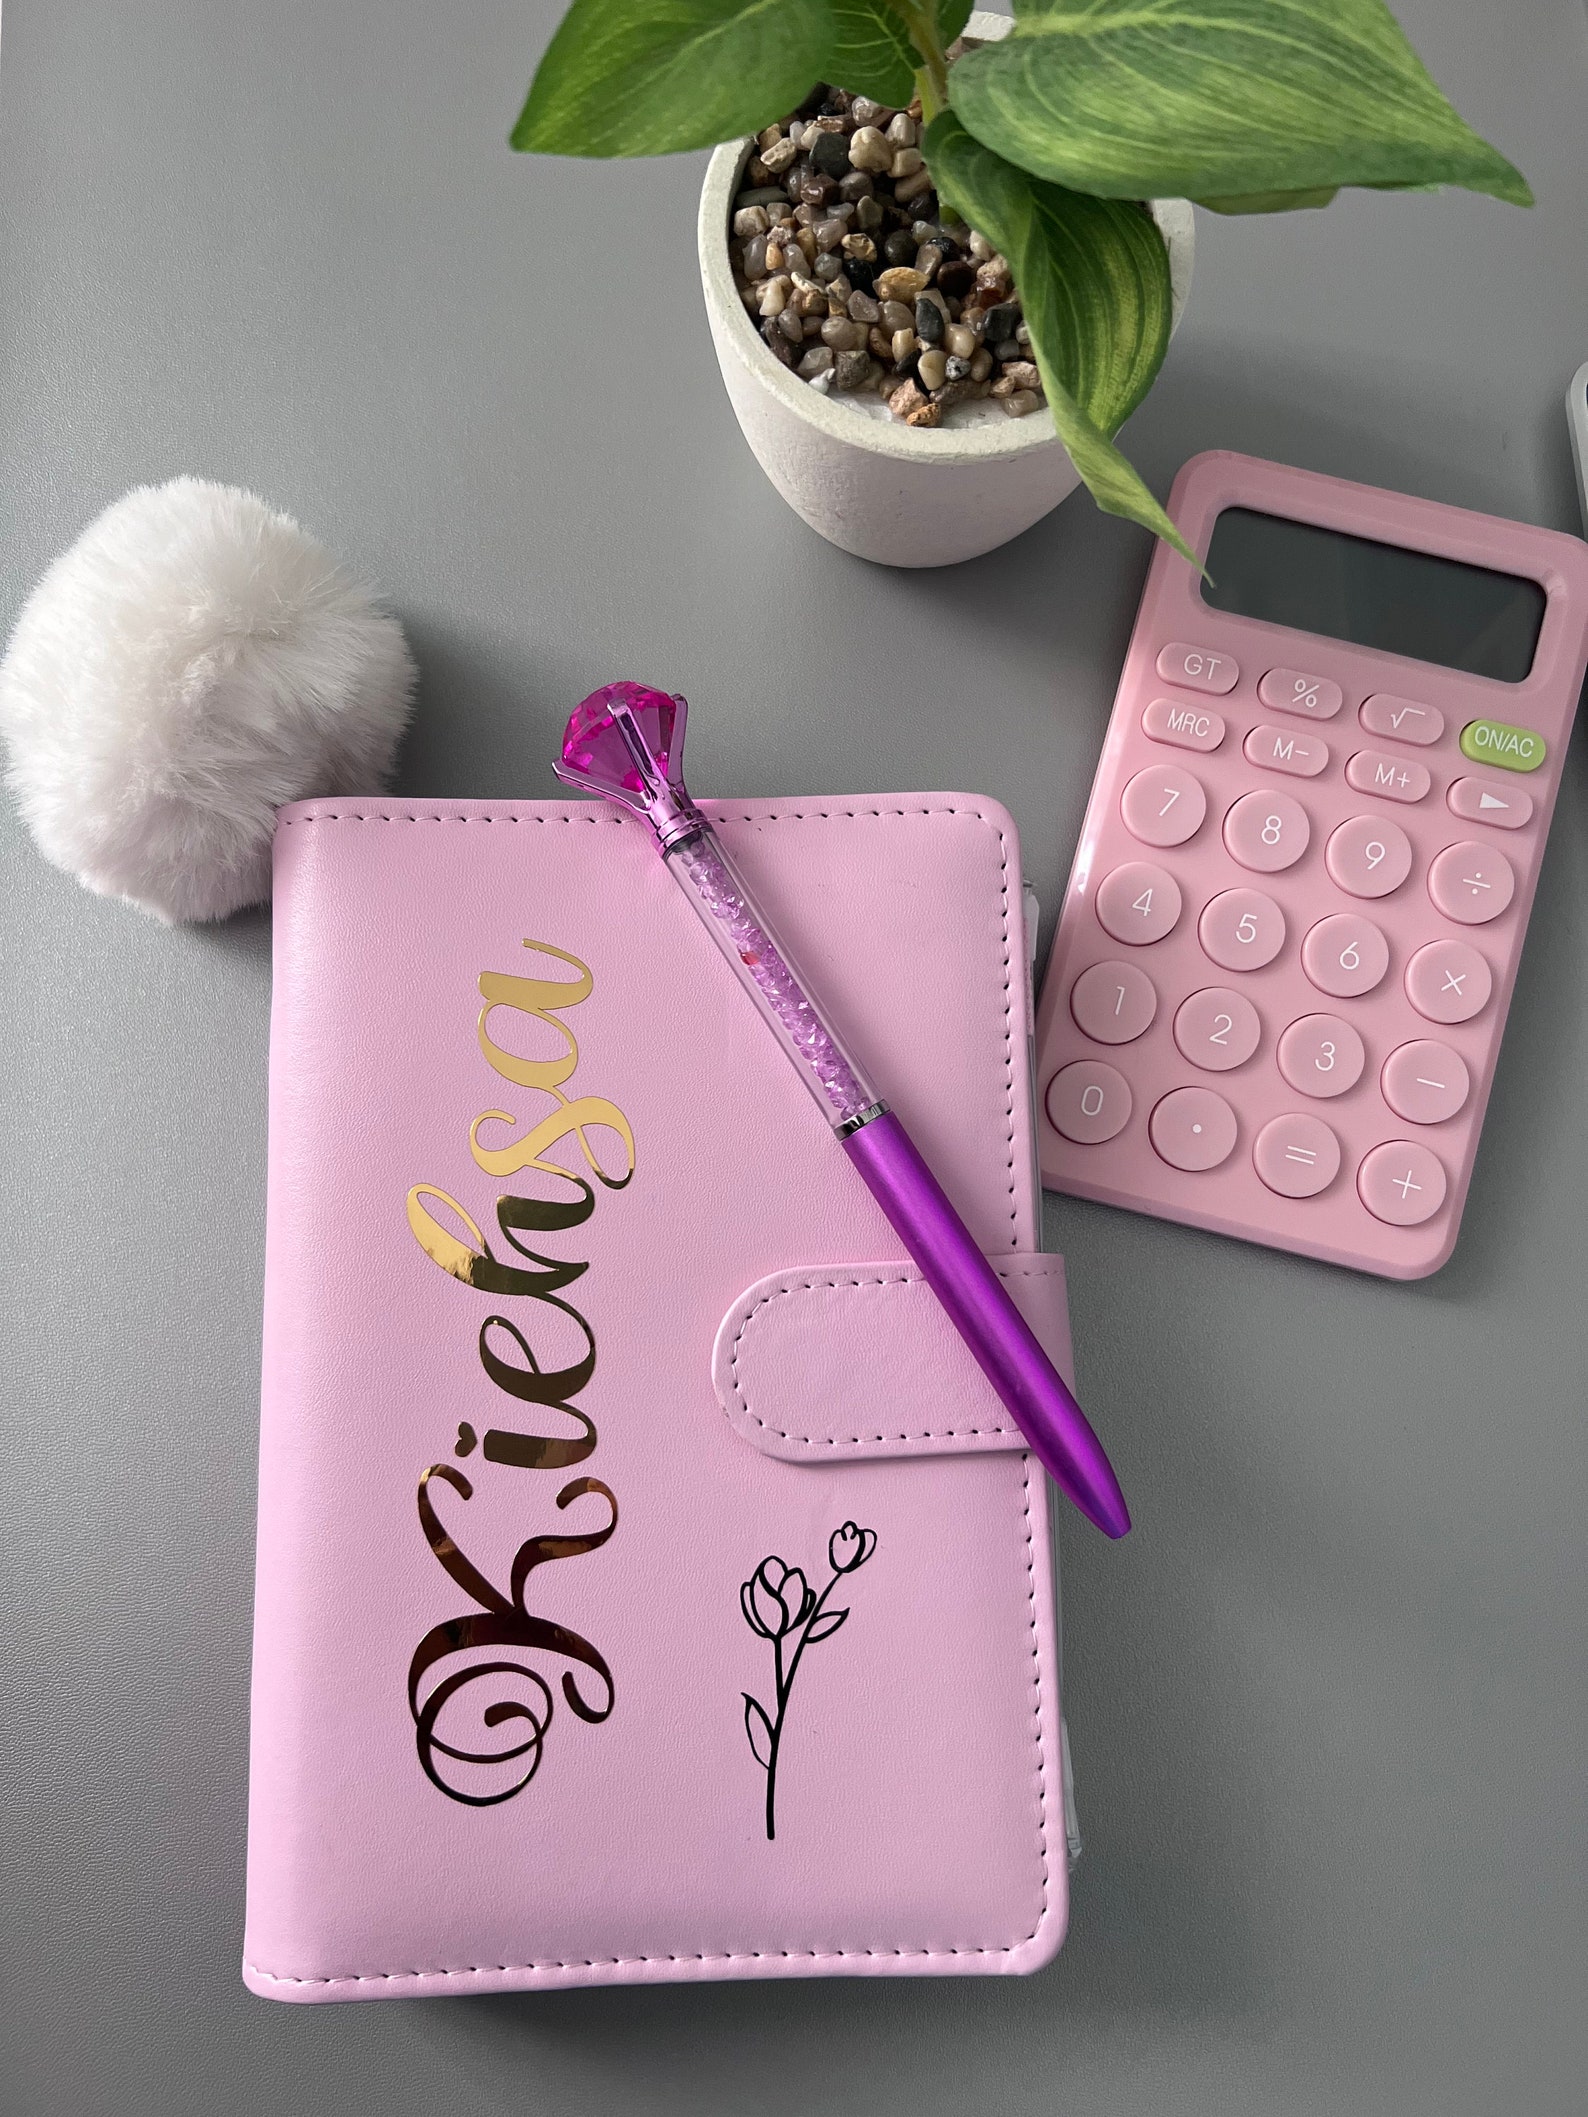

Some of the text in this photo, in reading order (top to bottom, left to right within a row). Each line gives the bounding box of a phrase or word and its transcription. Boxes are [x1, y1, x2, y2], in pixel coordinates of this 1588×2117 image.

[1183, 653, 1222, 681] GT
[1166, 709, 1210, 738] MRC
[1473, 726, 1535, 759] ON/AC
[1374, 763, 1412, 788] M+
[1158, 788, 1180, 818] 7
[1260, 815, 1282, 846] 8
[1364, 841, 1386, 871] 9
[1131, 888, 1154, 918] 4
[1235, 914, 1258, 944] 5
[1339, 941, 1360, 971] 6
[1114, 985, 1126, 1016] 1
[1208, 1014, 1233, 1046] 2
[1314, 1041, 1336, 1072] 3
[1080, 1085, 1104, 1117] 0
[407, 938, 635, 1807] Kiehsa
